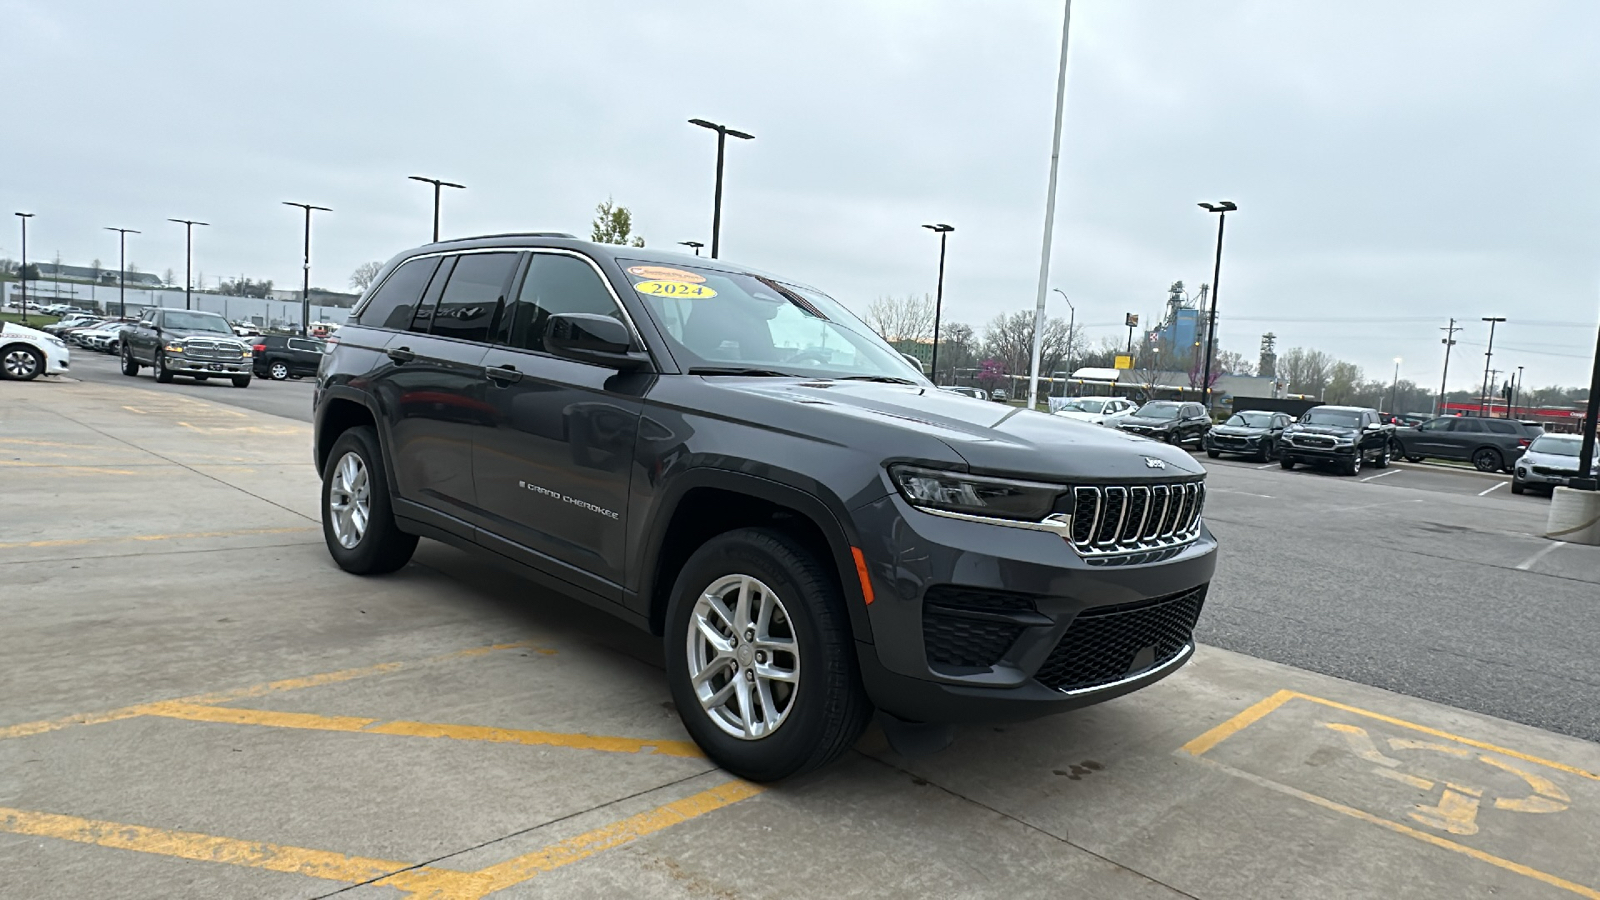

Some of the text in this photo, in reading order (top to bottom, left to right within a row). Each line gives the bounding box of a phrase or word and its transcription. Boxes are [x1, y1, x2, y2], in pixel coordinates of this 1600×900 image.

[651, 283, 703, 296] 2024
[1145, 457, 1166, 470] Jeep
[527, 483, 619, 520] GRAND CHEROKEE
